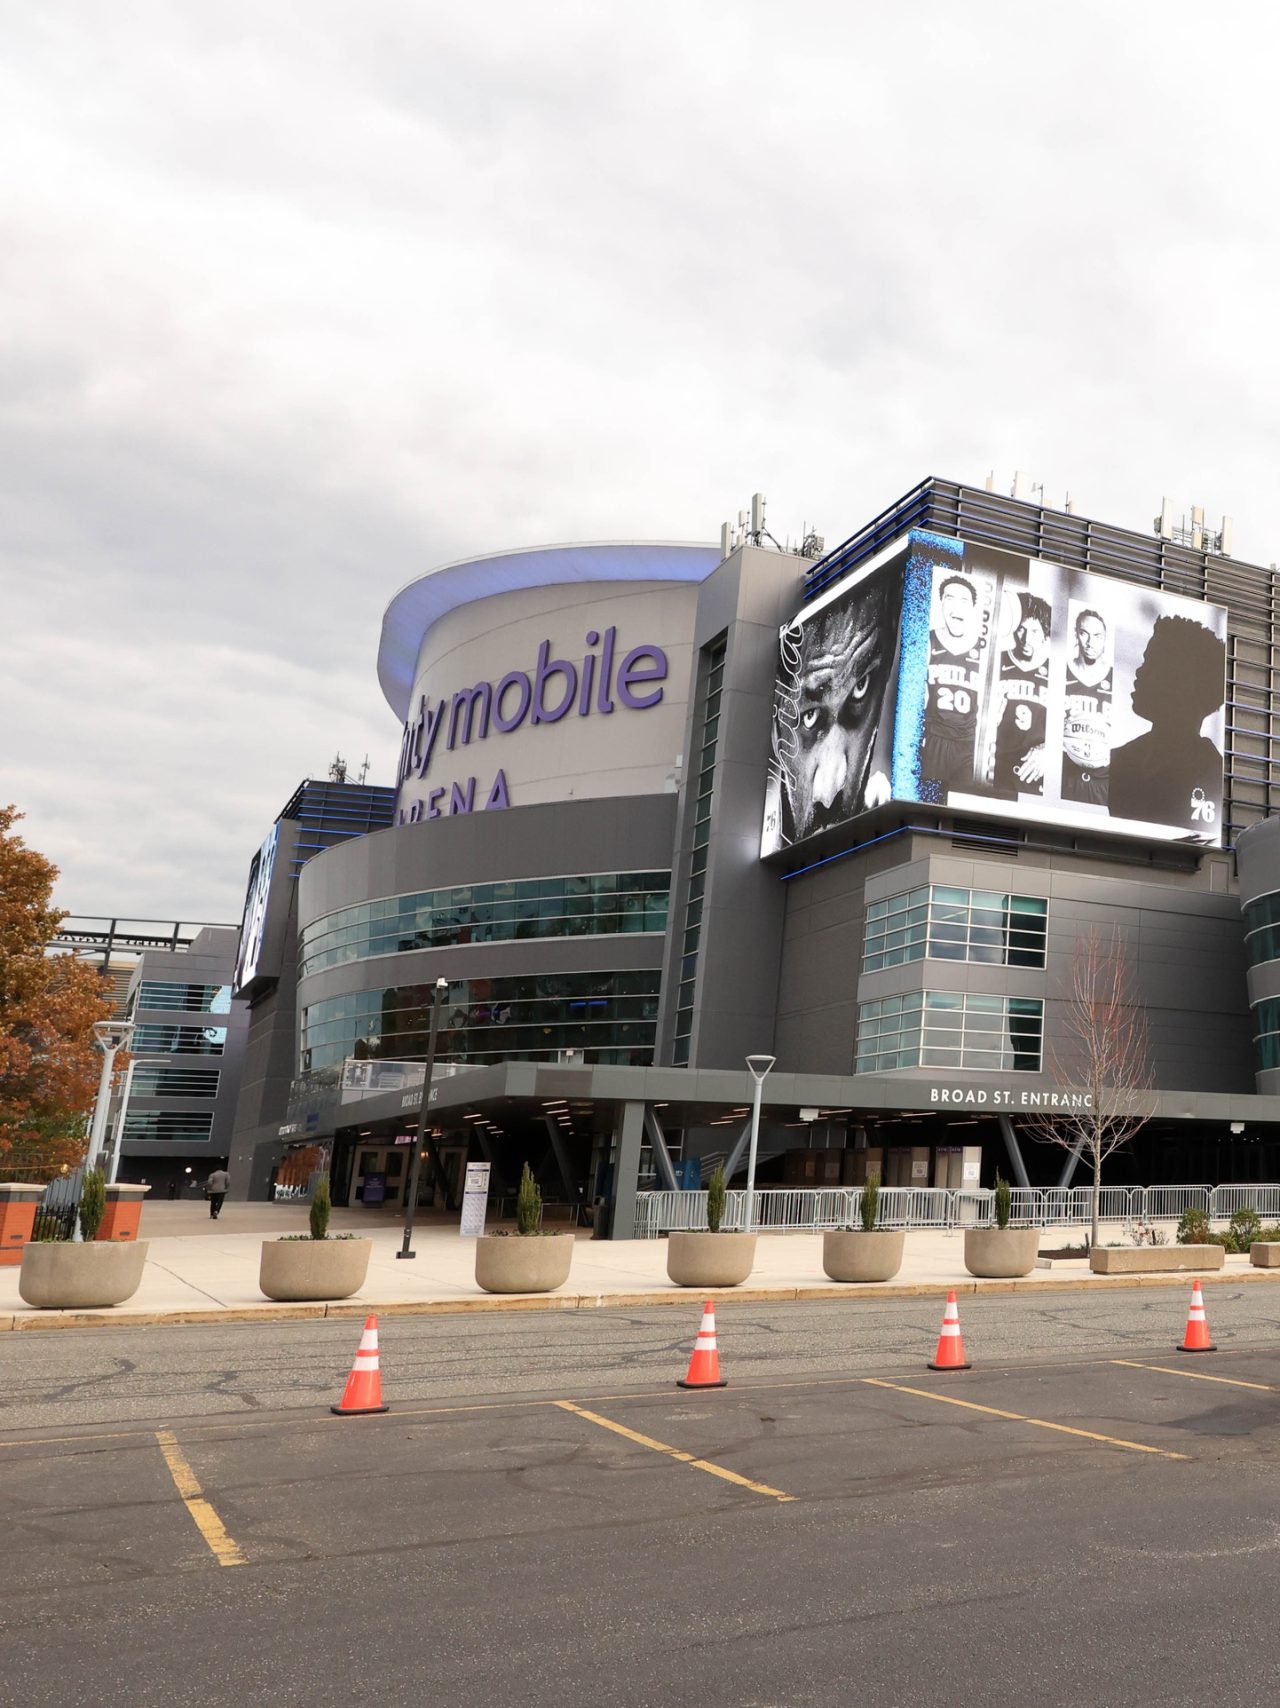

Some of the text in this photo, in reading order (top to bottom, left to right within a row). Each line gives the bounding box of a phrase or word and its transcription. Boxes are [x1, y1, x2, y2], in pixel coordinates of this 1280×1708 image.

[446, 625, 668, 751] mobile
[937, 687, 971, 713] 20
[1015, 704, 1032, 730] 9
[1191, 798, 1216, 823] 76
[930, 1088, 1093, 1108] BROAD ST. ENTRANC
